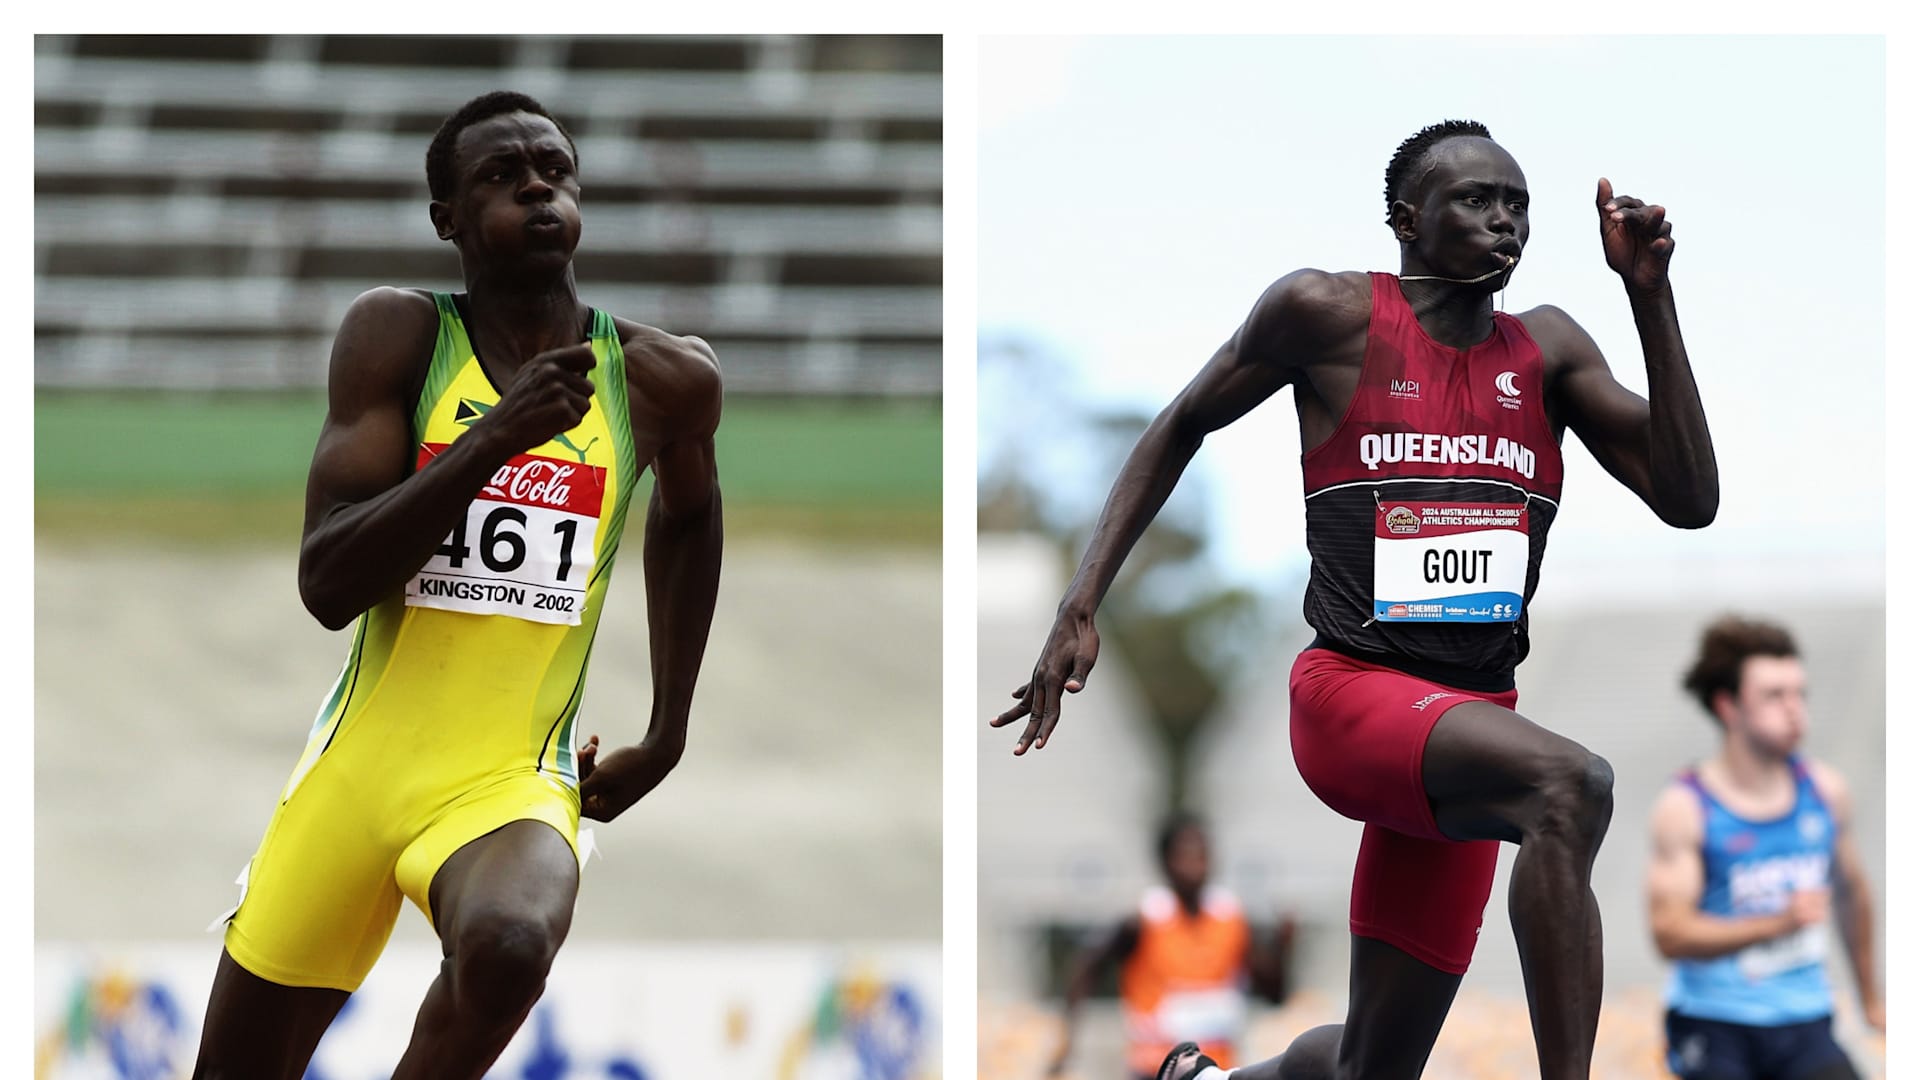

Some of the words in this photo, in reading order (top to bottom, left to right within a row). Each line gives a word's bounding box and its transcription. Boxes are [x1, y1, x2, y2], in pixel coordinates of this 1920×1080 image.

[1390, 379, 1420, 394] IMPI
[1360, 432, 1536, 480] QUEENSLAND
[1421, 508, 1439, 516] 2024
[1440, 508, 1482, 517] AUSTRALIAN
[1483, 509, 1494, 517] ALL
[1495, 509, 1520, 517] SCHOOLS
[1421, 517, 1463, 526] ATHLETICS
[1464, 517, 1520, 527] CHAMPIONSHIPS
[434, 505, 578, 582] 461
[1423, 549, 1493, 584] GOUT
[420, 578, 526, 605] KINGSTON
[533, 592, 575, 613] 2002
[1408, 604, 1443, 613] CHEMIST
